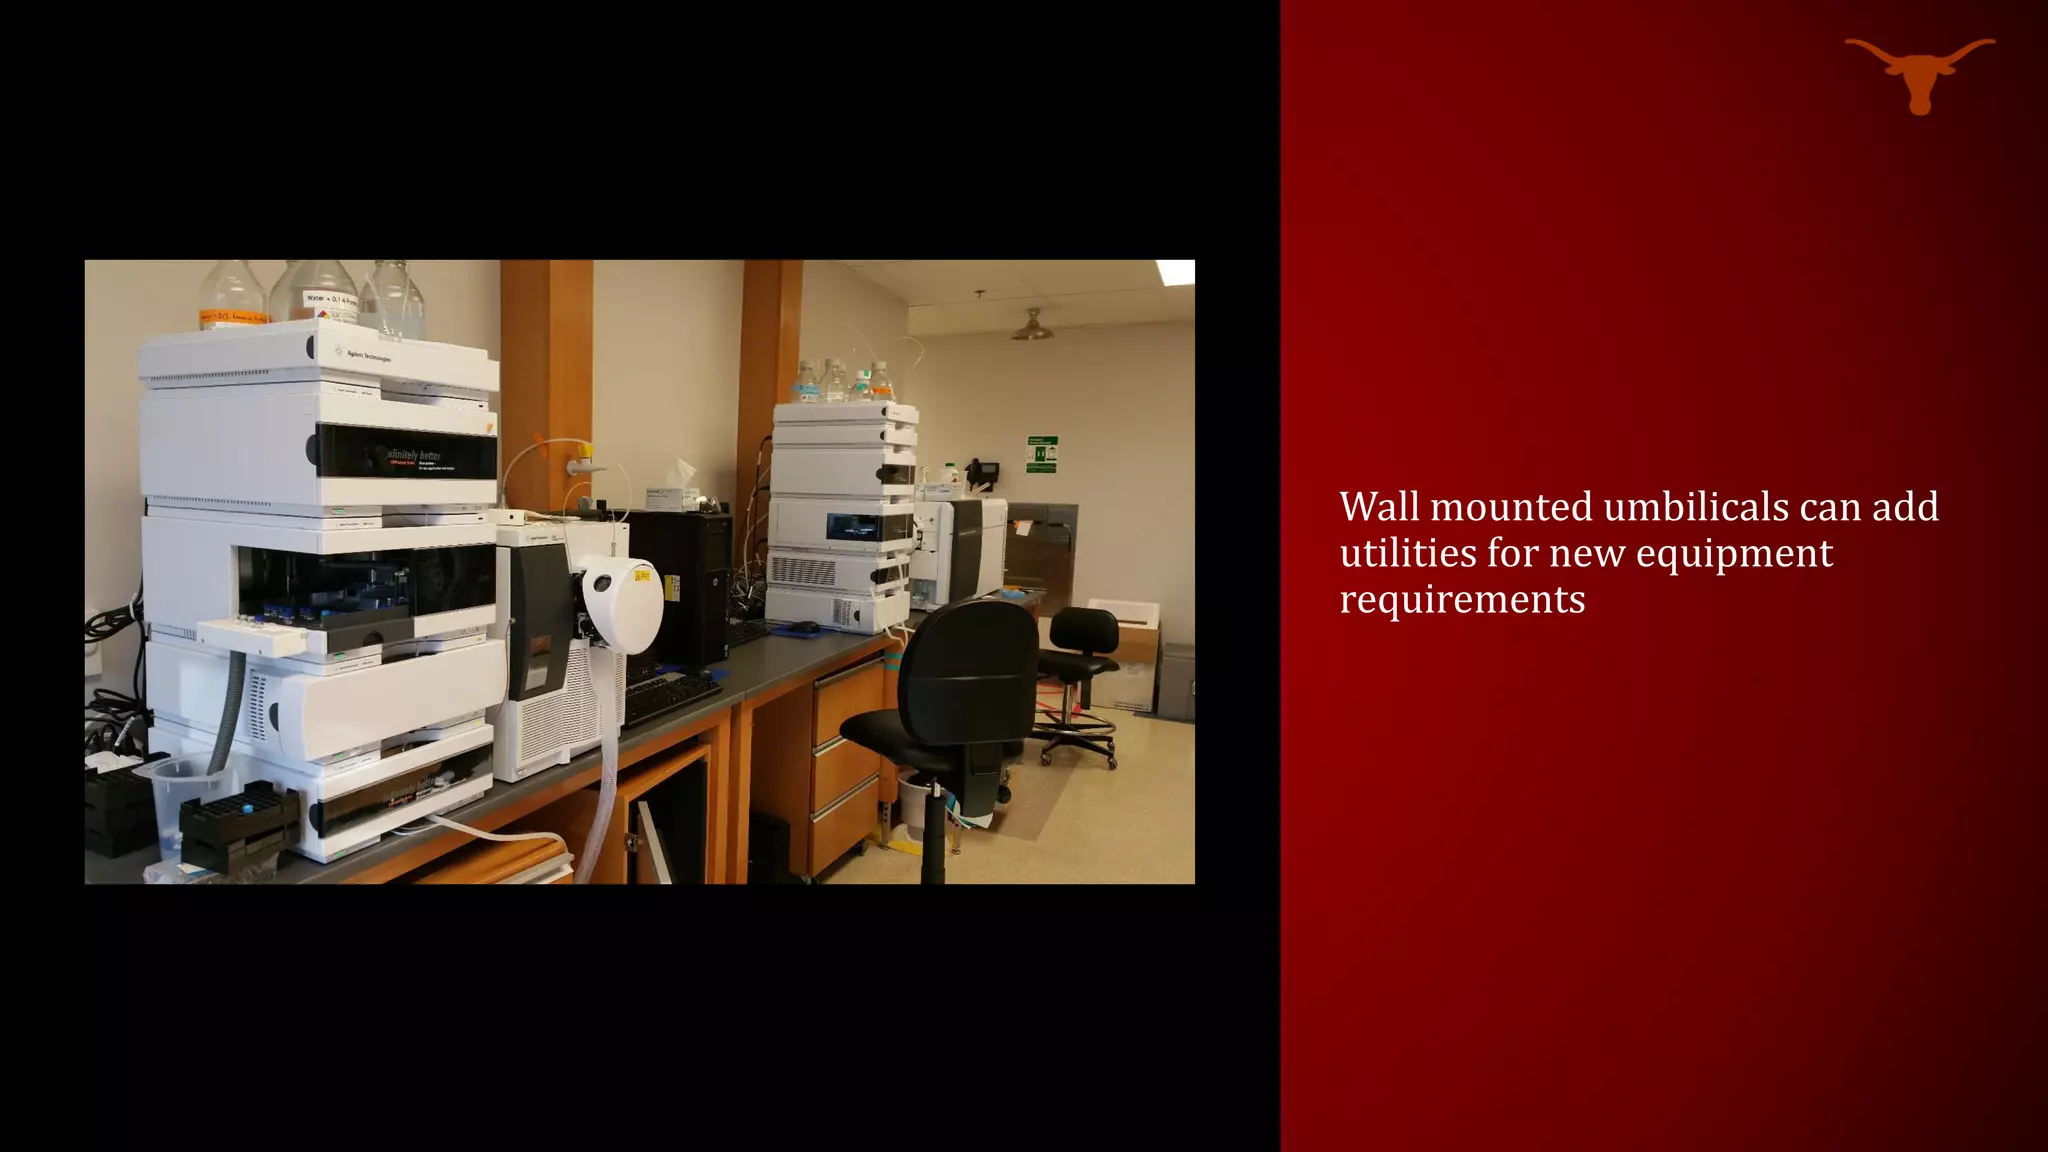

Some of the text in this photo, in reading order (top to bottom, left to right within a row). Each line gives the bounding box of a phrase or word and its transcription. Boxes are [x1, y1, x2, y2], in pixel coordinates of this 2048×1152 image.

[307, 294, 325, 302] Water
[347, 349, 392, 363] Agilent Technologies
